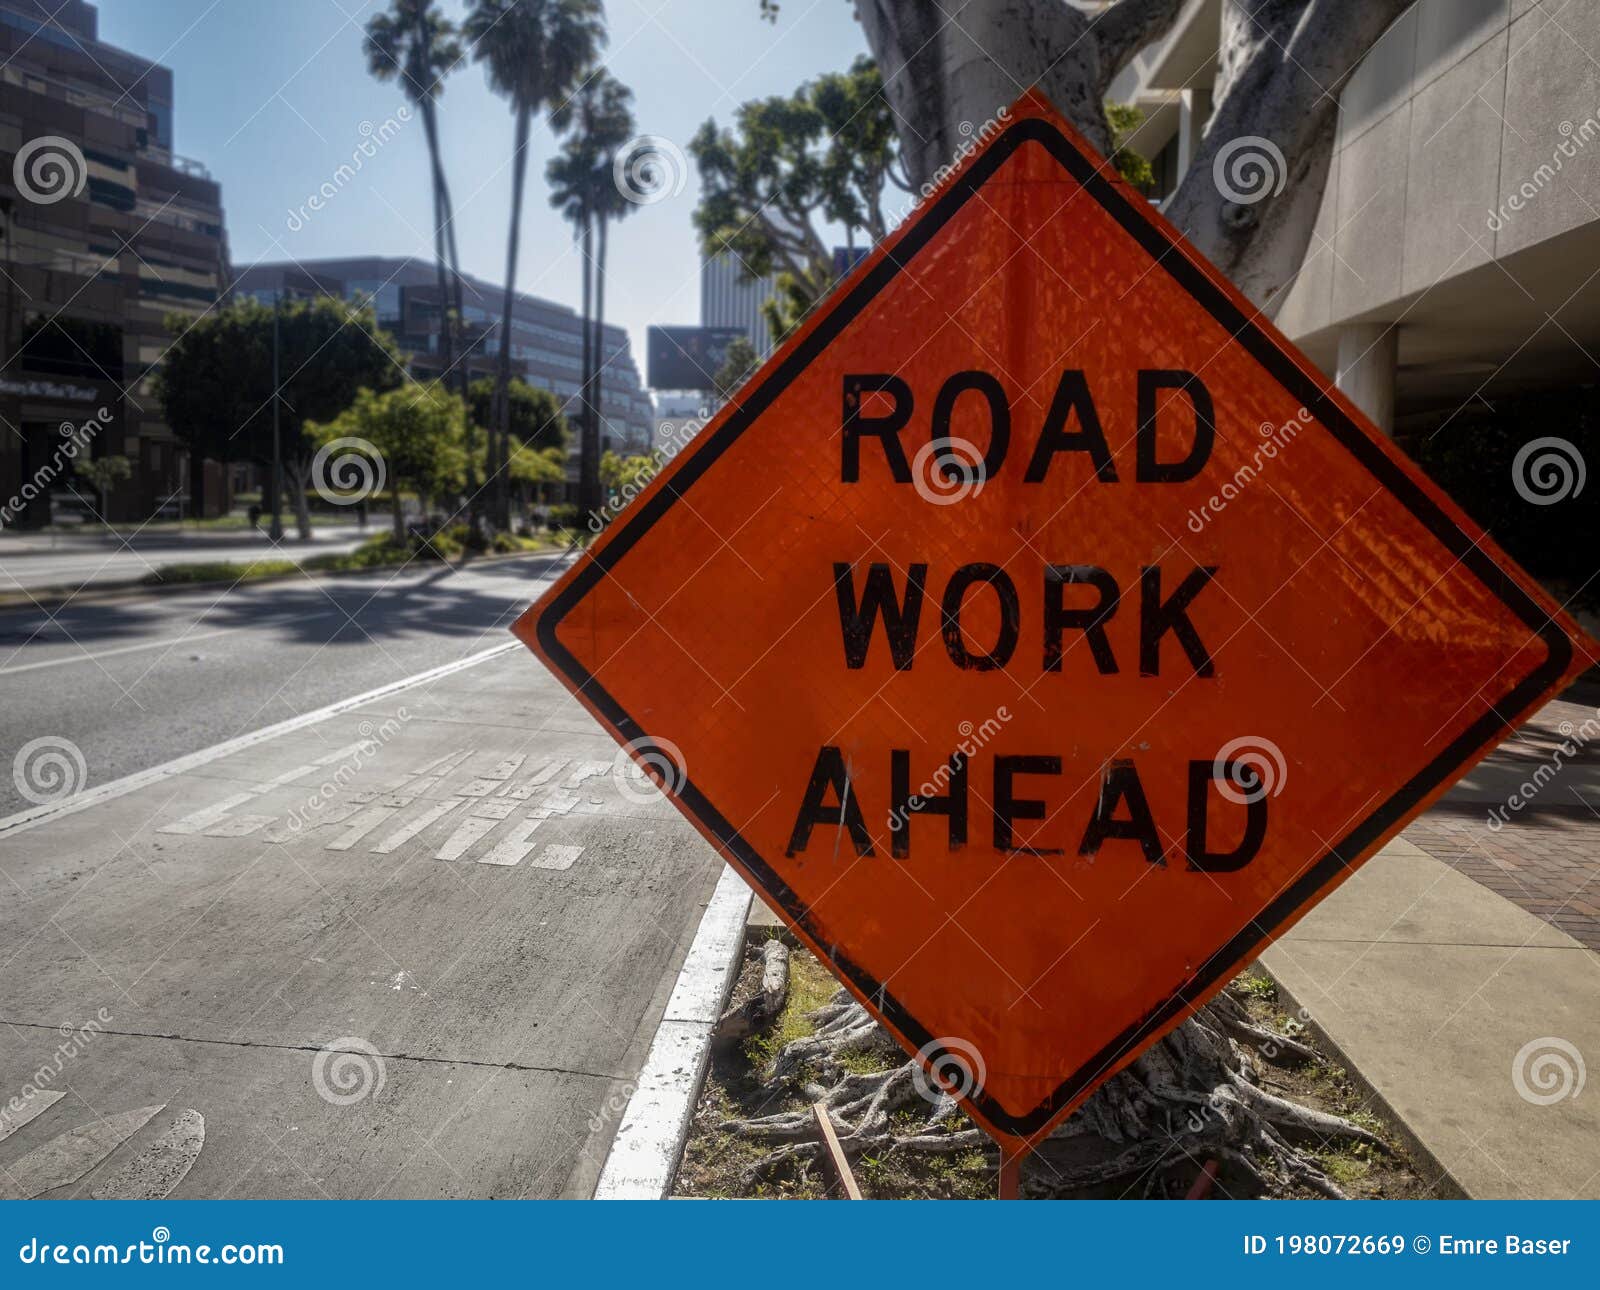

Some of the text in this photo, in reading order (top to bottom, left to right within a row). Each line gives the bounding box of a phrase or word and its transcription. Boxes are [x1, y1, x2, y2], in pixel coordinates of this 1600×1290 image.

[841, 369, 1216, 483] ROAD
[833, 562, 1219, 678] WORK
[785, 746, 1269, 873] AHEAD
